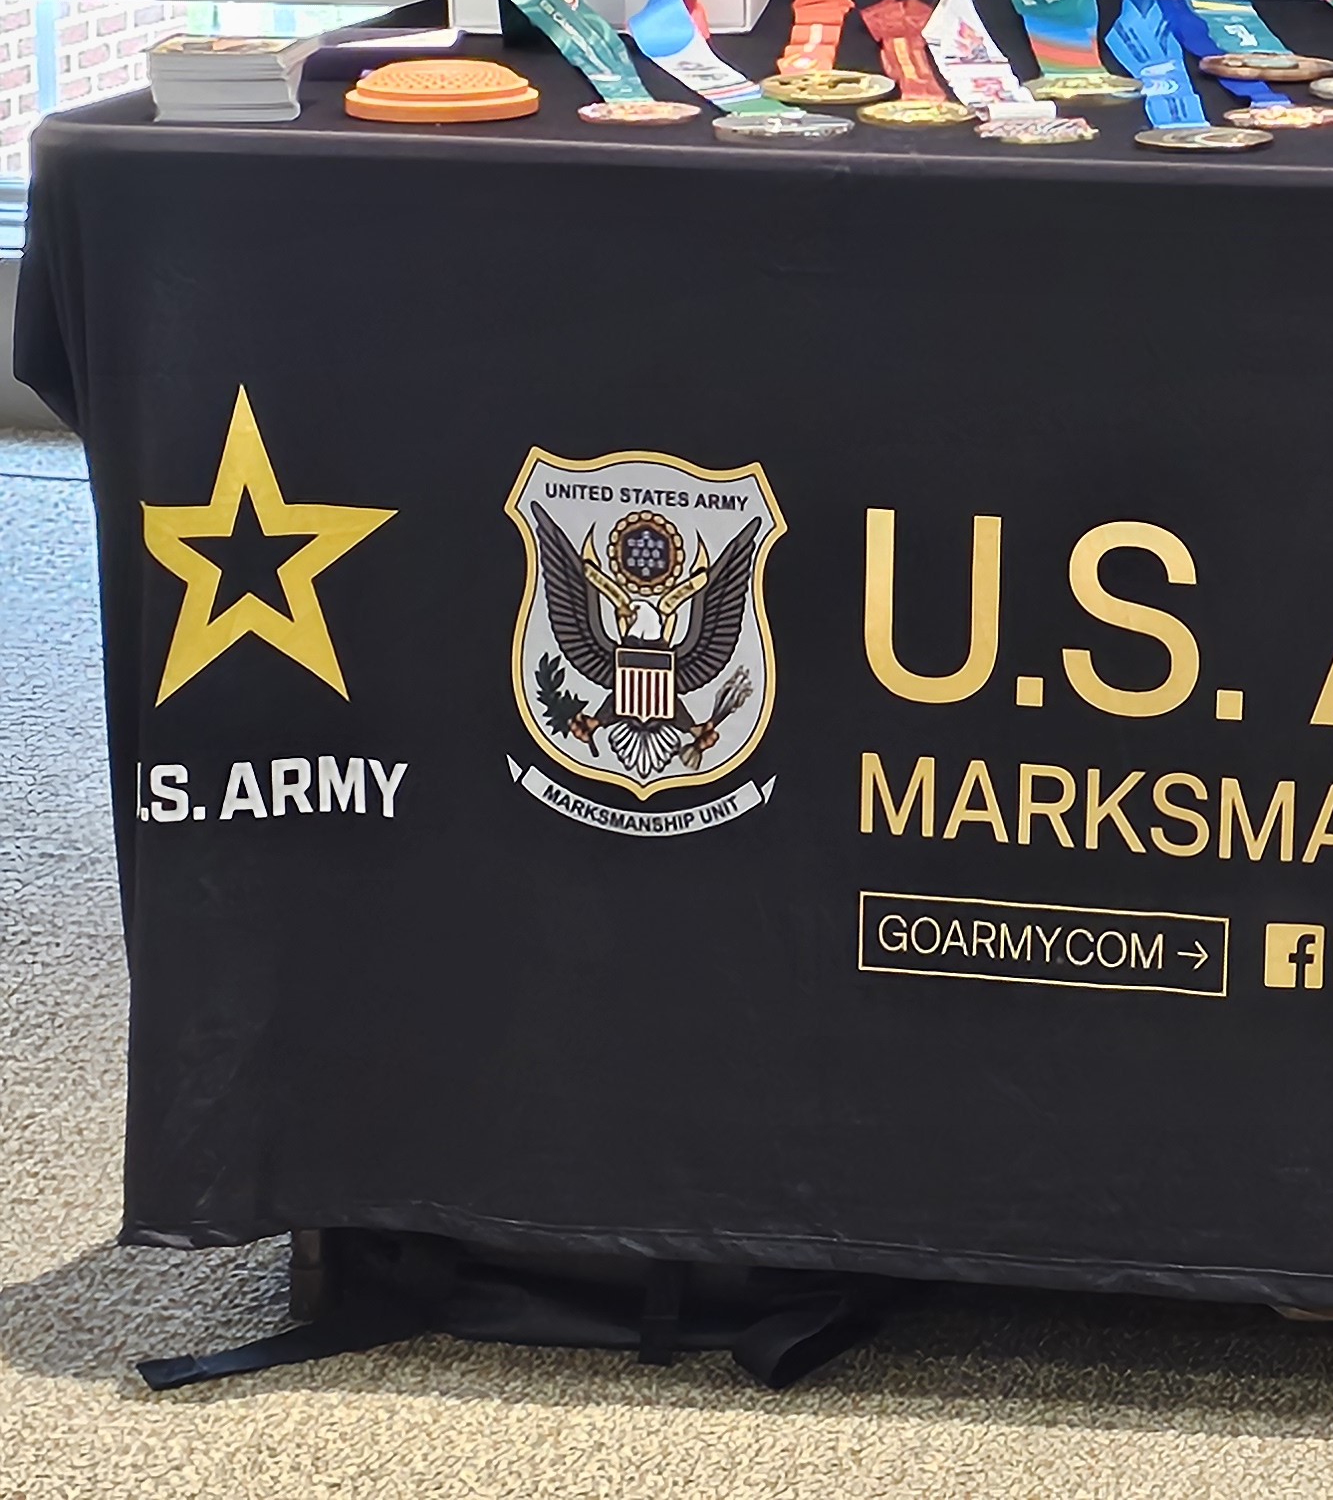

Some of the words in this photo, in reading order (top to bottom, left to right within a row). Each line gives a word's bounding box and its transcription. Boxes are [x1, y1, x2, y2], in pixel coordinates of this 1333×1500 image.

[545, 482, 614, 502] UNITED
[620, 487, 689, 508] STATES
[694, 495, 749, 512] ARMY
[862, 508, 1245, 722] U.S.
[218, 754, 409, 820] ARMY
[541, 785, 695, 833] MARKSMANSHIP
[700, 795, 738, 824] UNIT
